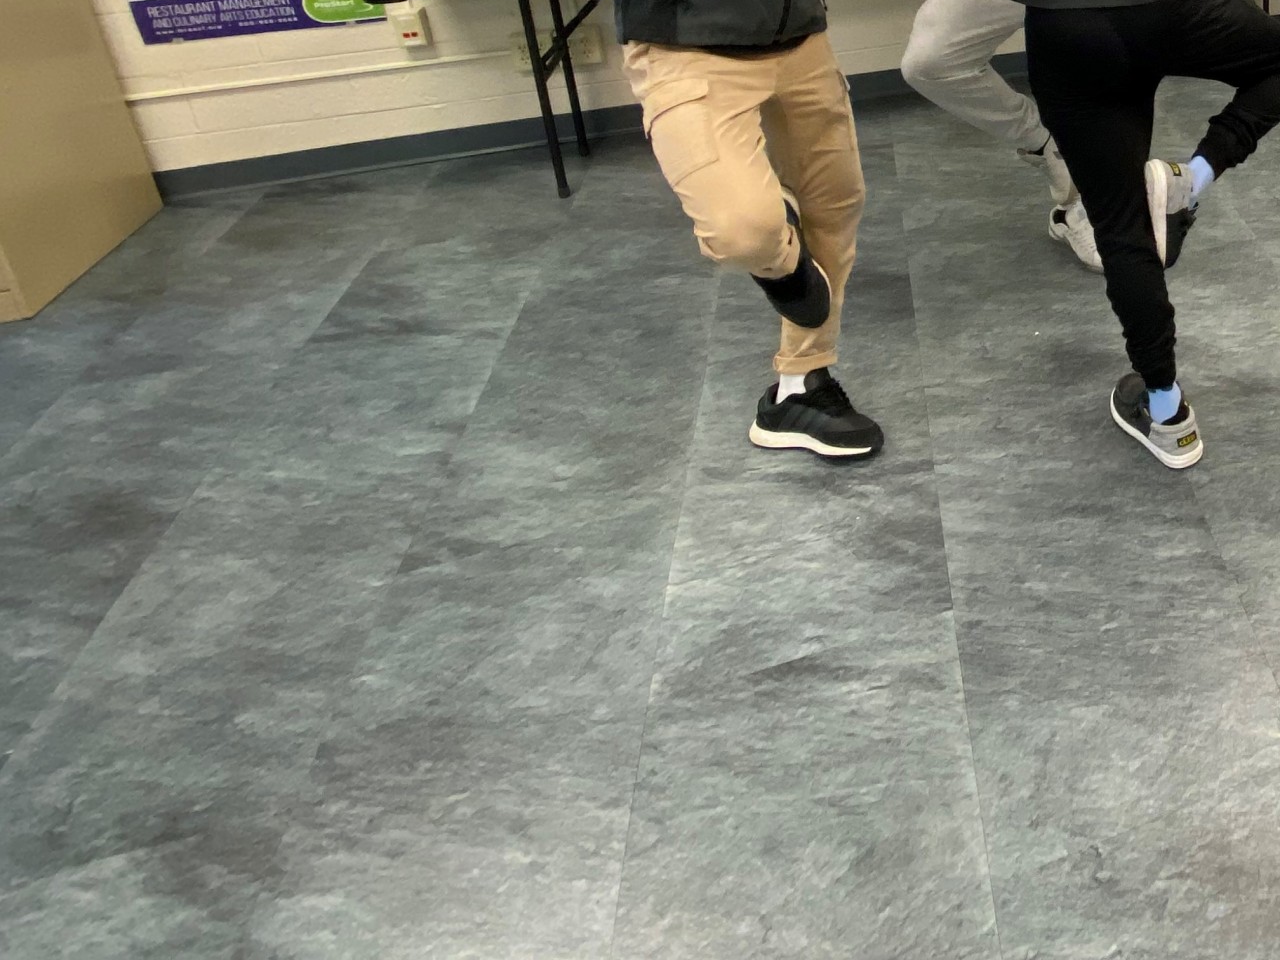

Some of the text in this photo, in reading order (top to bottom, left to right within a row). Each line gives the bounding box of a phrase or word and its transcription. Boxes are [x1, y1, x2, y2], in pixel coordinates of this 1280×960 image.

[147, 1, 215, 18] RESTAURANT
[172, 13, 217, 27] CULINARY
[220, 10, 245, 22] ARTS
[246, 6, 296, 20] EDUCATION
